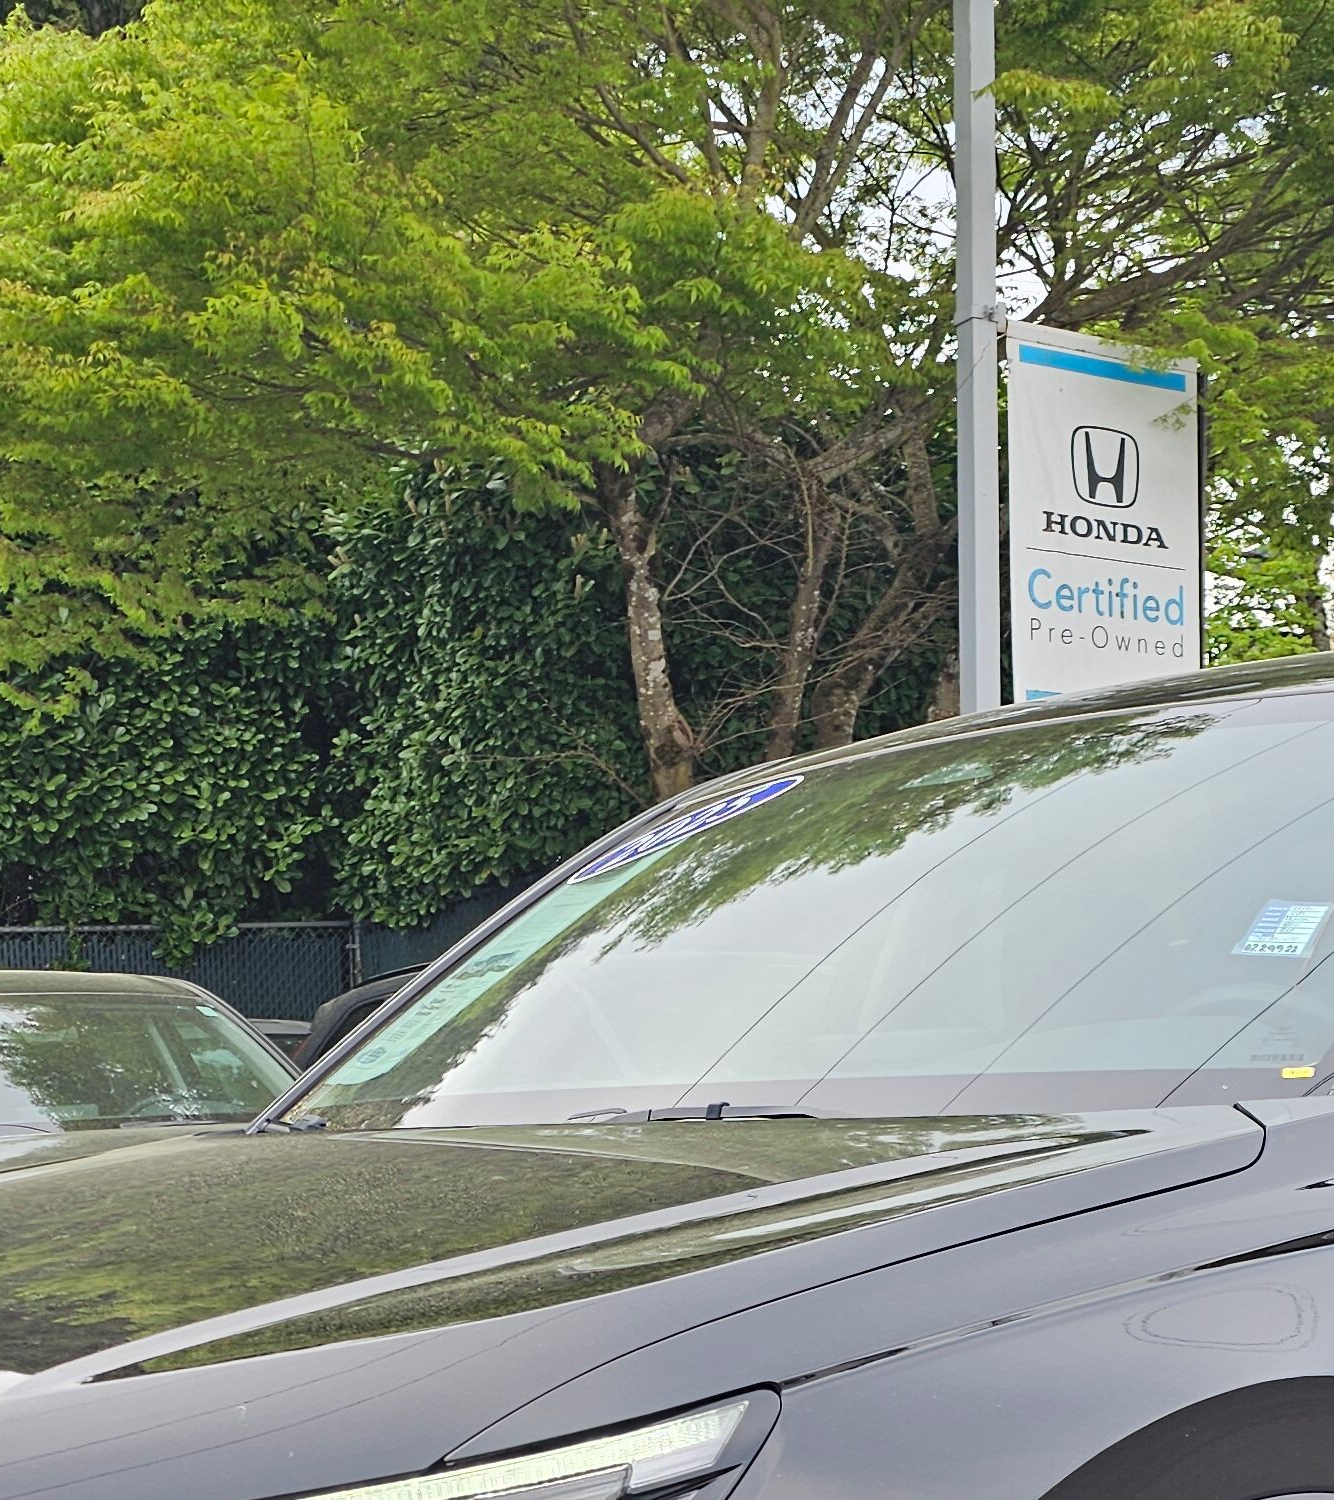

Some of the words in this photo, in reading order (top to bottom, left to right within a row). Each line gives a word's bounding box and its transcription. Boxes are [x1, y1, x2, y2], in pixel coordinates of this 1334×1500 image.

[1042, 510, 1169, 549] HONDA
[1027, 568, 1184, 627] Certified
[1030, 617, 1184, 659] Pre-Owned
